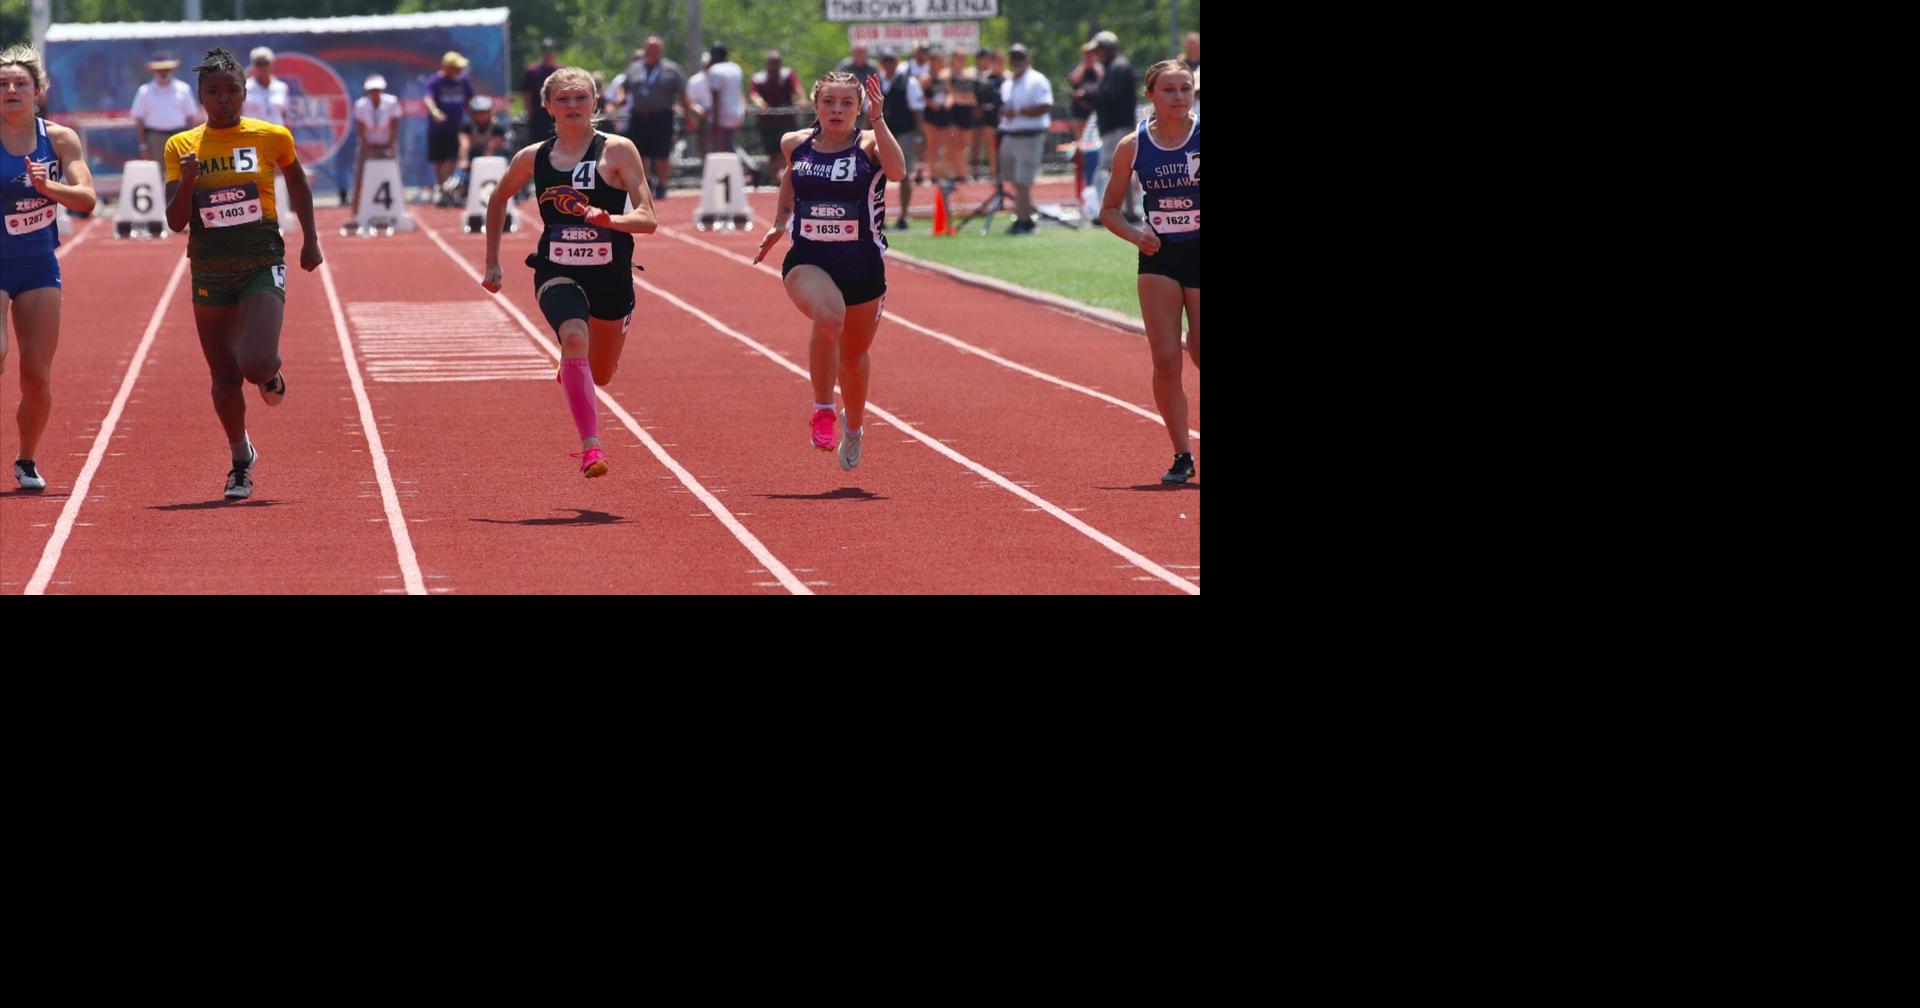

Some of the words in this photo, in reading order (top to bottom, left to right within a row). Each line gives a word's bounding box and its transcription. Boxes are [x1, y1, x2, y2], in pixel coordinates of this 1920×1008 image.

[238, 149, 254, 171] 5
[48, 162, 58, 181] 6
[574, 162, 592, 188] 4
[835, 158, 851, 180] 3
[372, 181, 393, 211] 4
[716, 174, 730, 204] 1
[132, 184, 153, 213] 6
[208, 189, 246, 204] ZERO
[1158, 198, 1193, 209] ZERO
[219, 207, 245, 219] 1403
[811, 205, 846, 217] ZERO
[23, 213, 43, 227] 1287
[1165, 215, 1190, 225] 1622
[562, 229, 598, 240] ZERO
[816, 224, 840, 234] 1635
[567, 247, 594, 258] 1472
